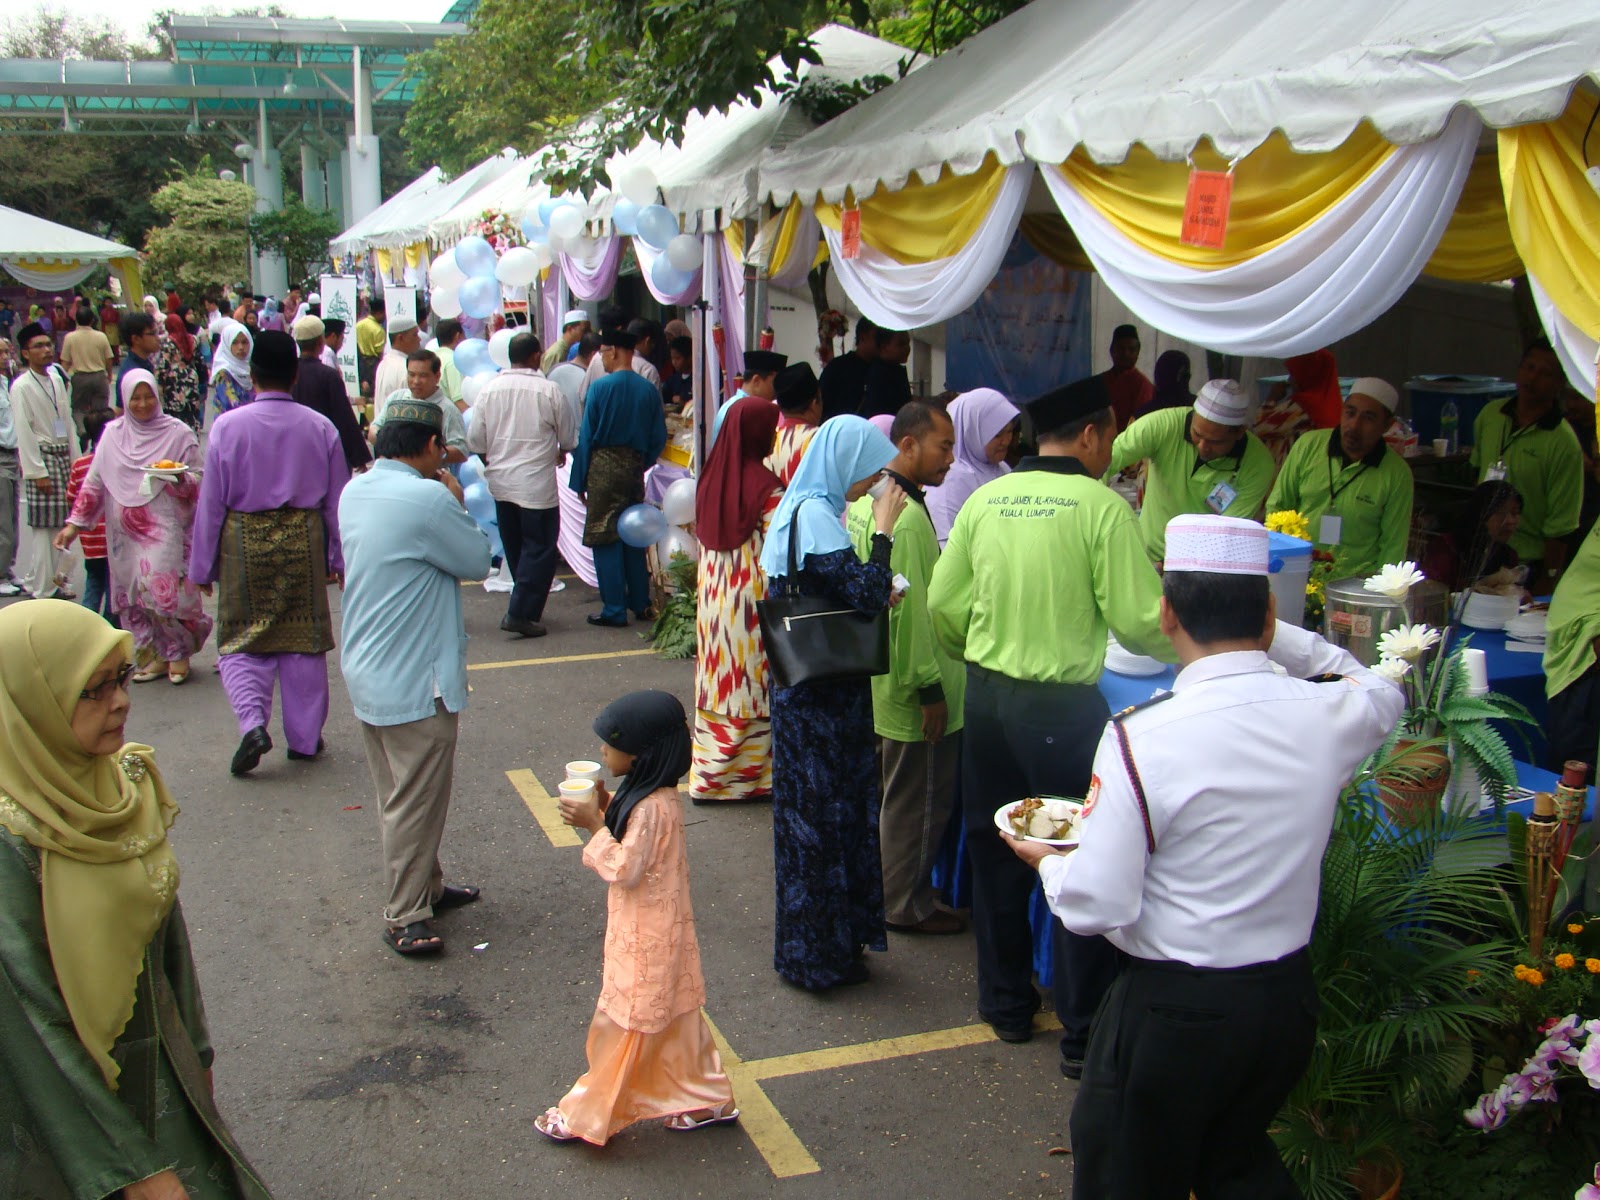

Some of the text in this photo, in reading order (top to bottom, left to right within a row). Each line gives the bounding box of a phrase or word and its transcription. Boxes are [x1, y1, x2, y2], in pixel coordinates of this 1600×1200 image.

[987, 496, 1009, 505] MASJID
[1011, 495, 1032, 505] JAMEK
[1000, 508, 1055, 517] KUALA LUMPUR
